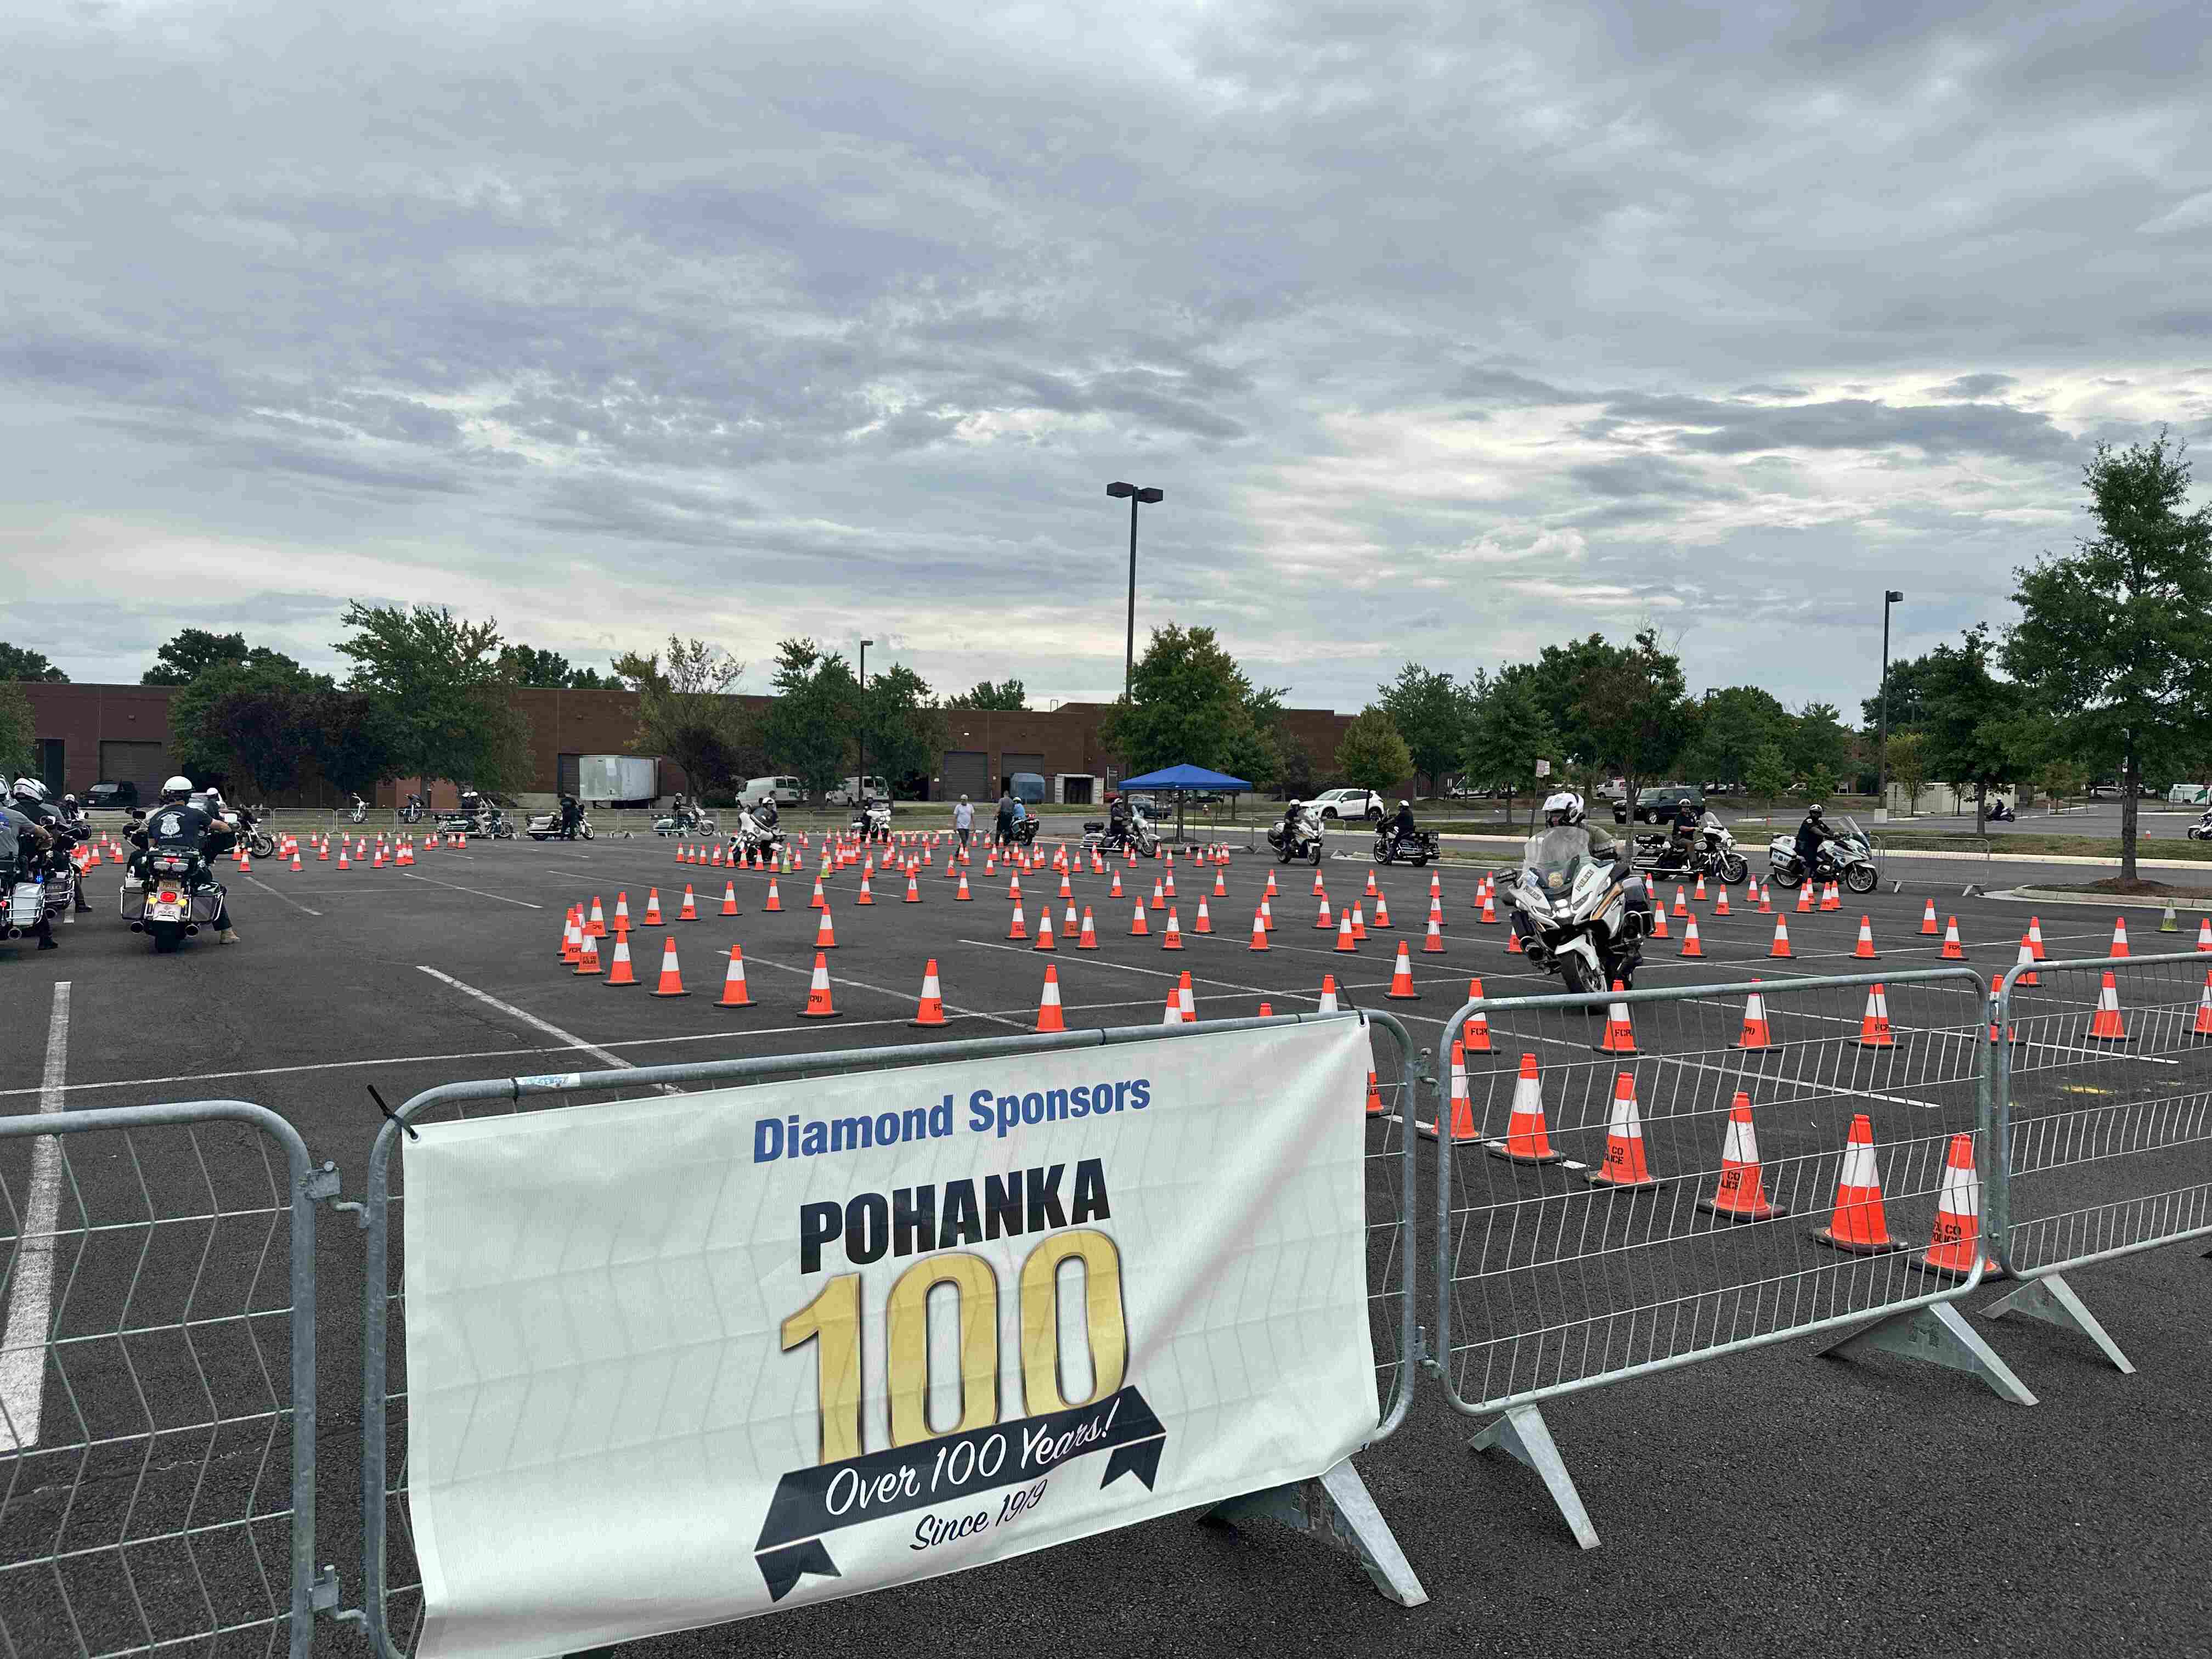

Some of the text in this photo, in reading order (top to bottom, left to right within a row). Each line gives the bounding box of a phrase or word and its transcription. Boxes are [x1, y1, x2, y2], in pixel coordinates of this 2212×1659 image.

[754, 1079, 1151, 1164] Diamond Sponsors
[800, 1157, 1110, 1274] POHANKA
[1945, 1224, 1961, 1235] CO
[781, 1228, 1130, 1466] 100
[825, 1397, 1121, 1515] Over 100 Years!
[910, 1479, 1049, 1551] Since 1919
